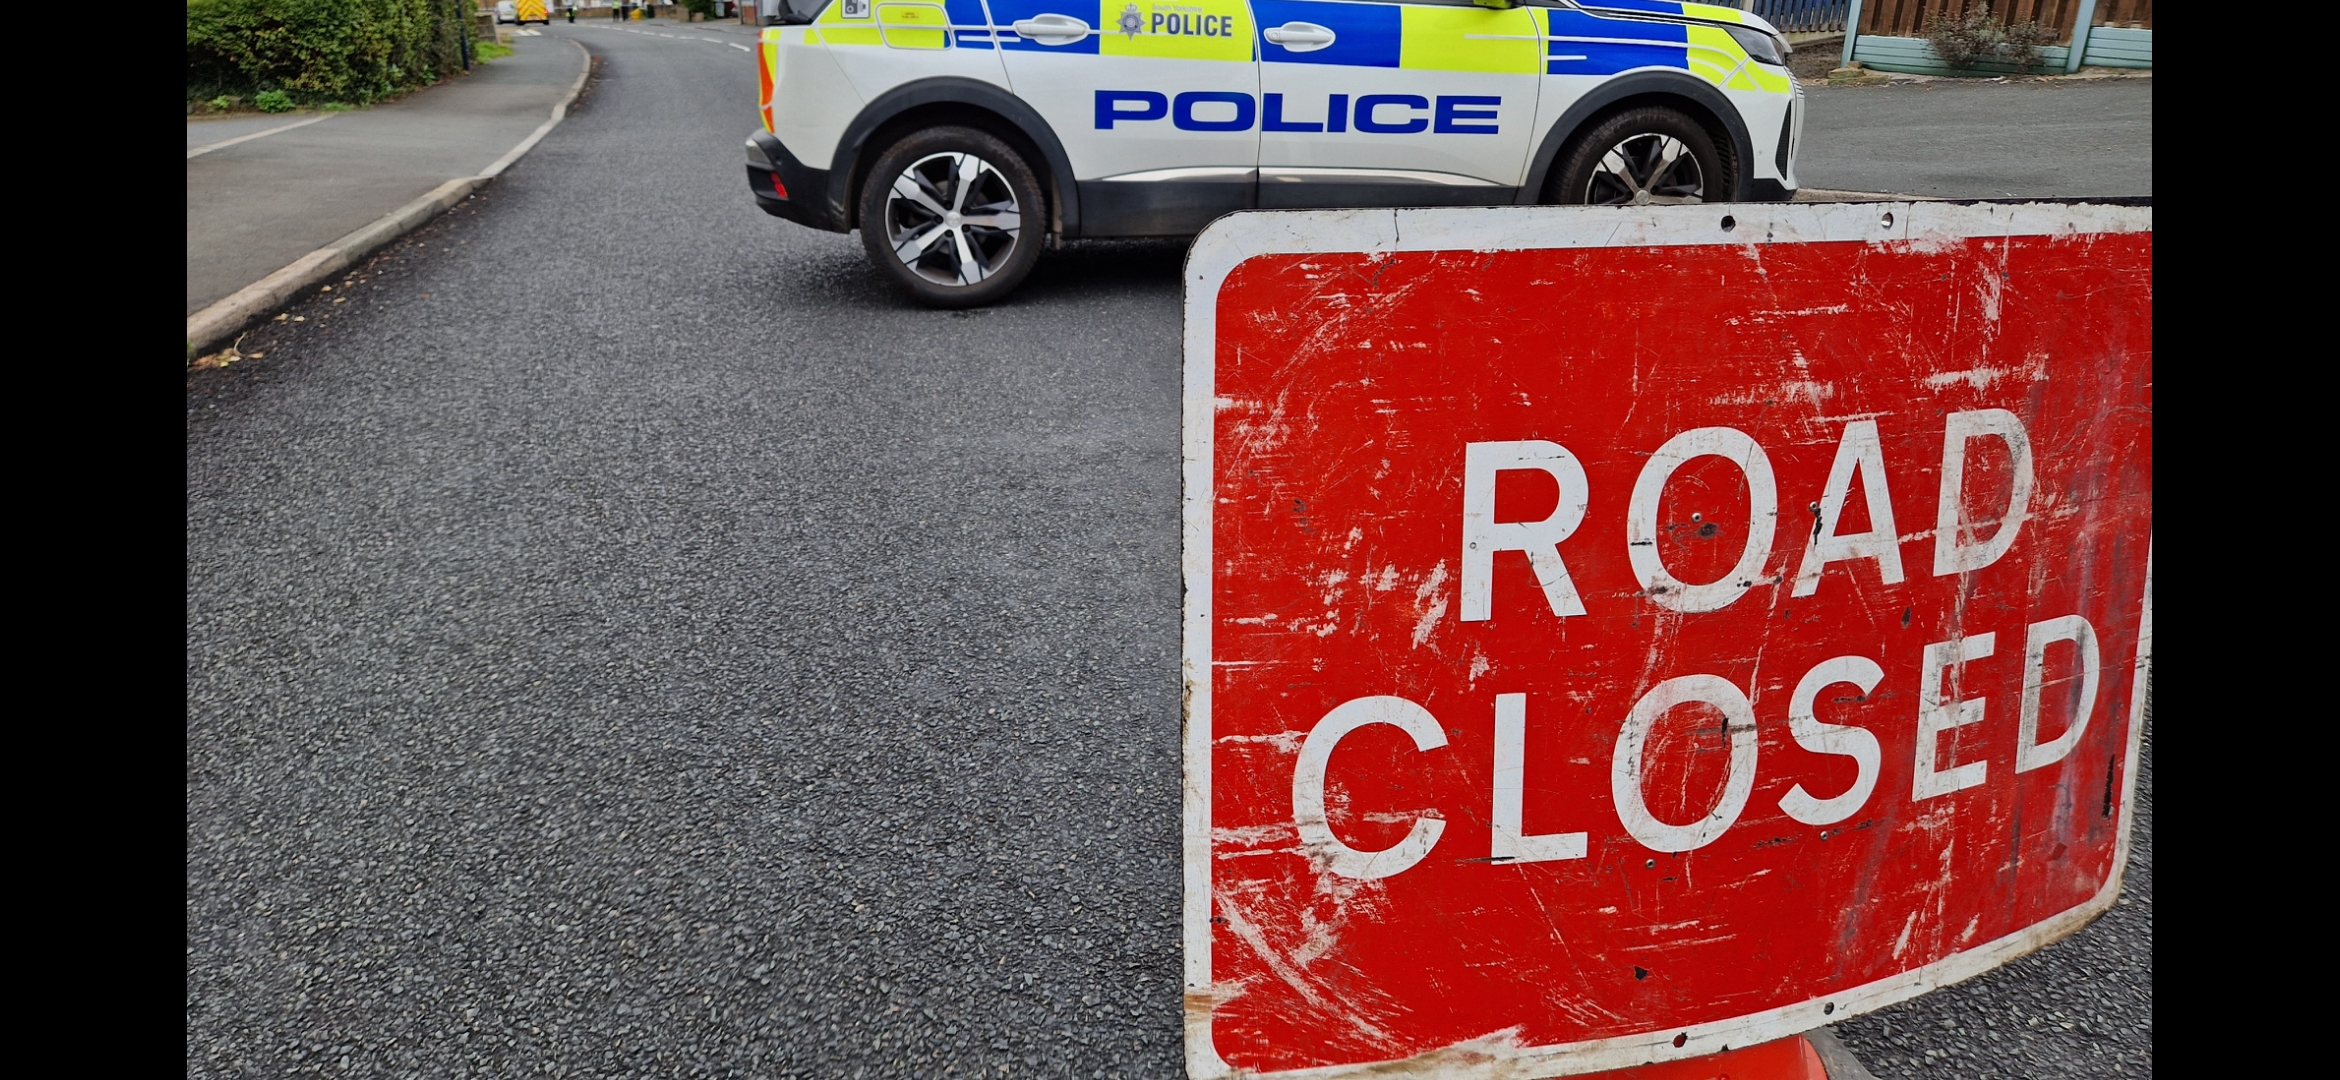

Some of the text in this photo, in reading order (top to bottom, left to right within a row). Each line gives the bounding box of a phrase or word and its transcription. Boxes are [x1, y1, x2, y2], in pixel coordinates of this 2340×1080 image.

[1151, 12, 1233, 37] POLICE
[1152, 4, 1203, 13] South Yorkshire
[1094, 90, 1502, 135] POLICE
[1460, 408, 2034, 621] ROAD
[1292, 614, 2101, 881] CLOSED
